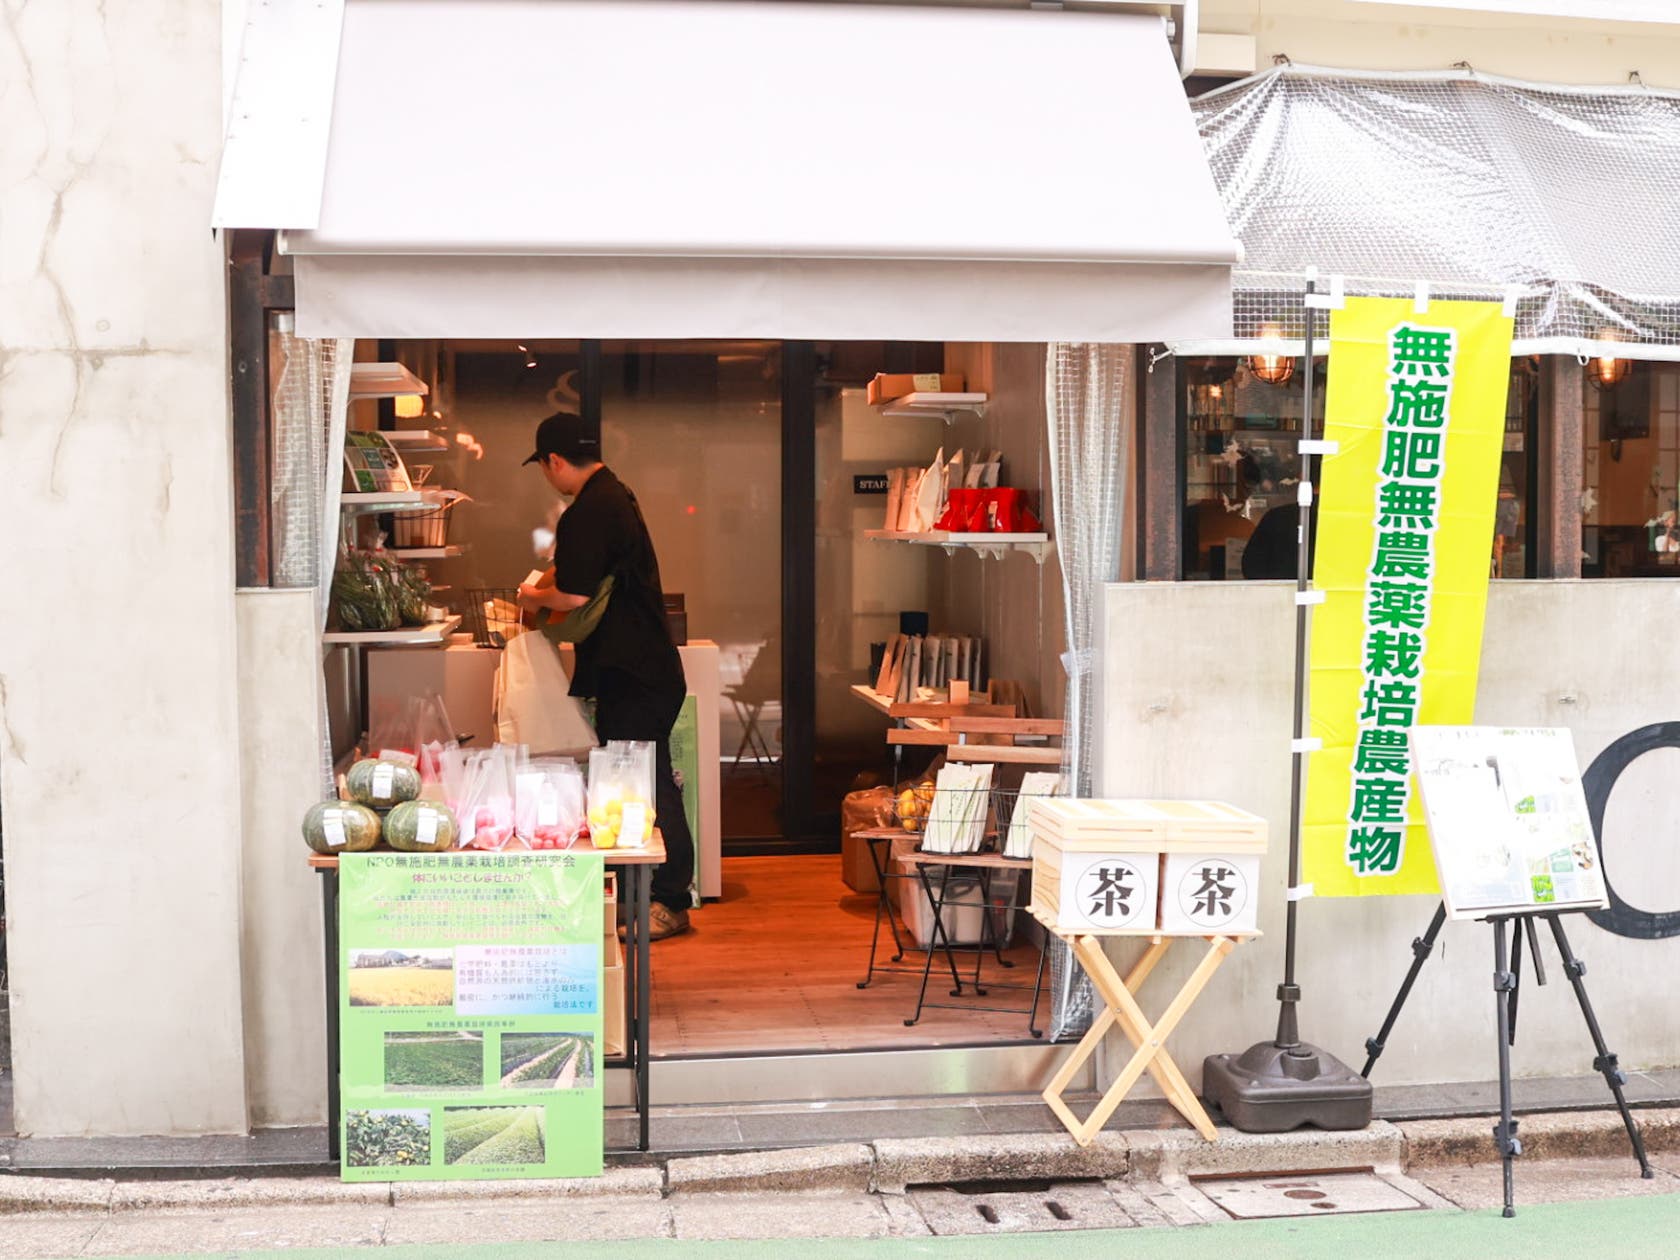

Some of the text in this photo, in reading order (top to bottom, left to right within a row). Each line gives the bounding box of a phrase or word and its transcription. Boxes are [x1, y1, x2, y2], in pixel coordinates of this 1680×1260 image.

[1349, 326, 1452, 873] 無施肥無農薬栽培農産物
[1088, 868, 1134, 917] 茶
[1190, 867, 1236, 916] 茶
